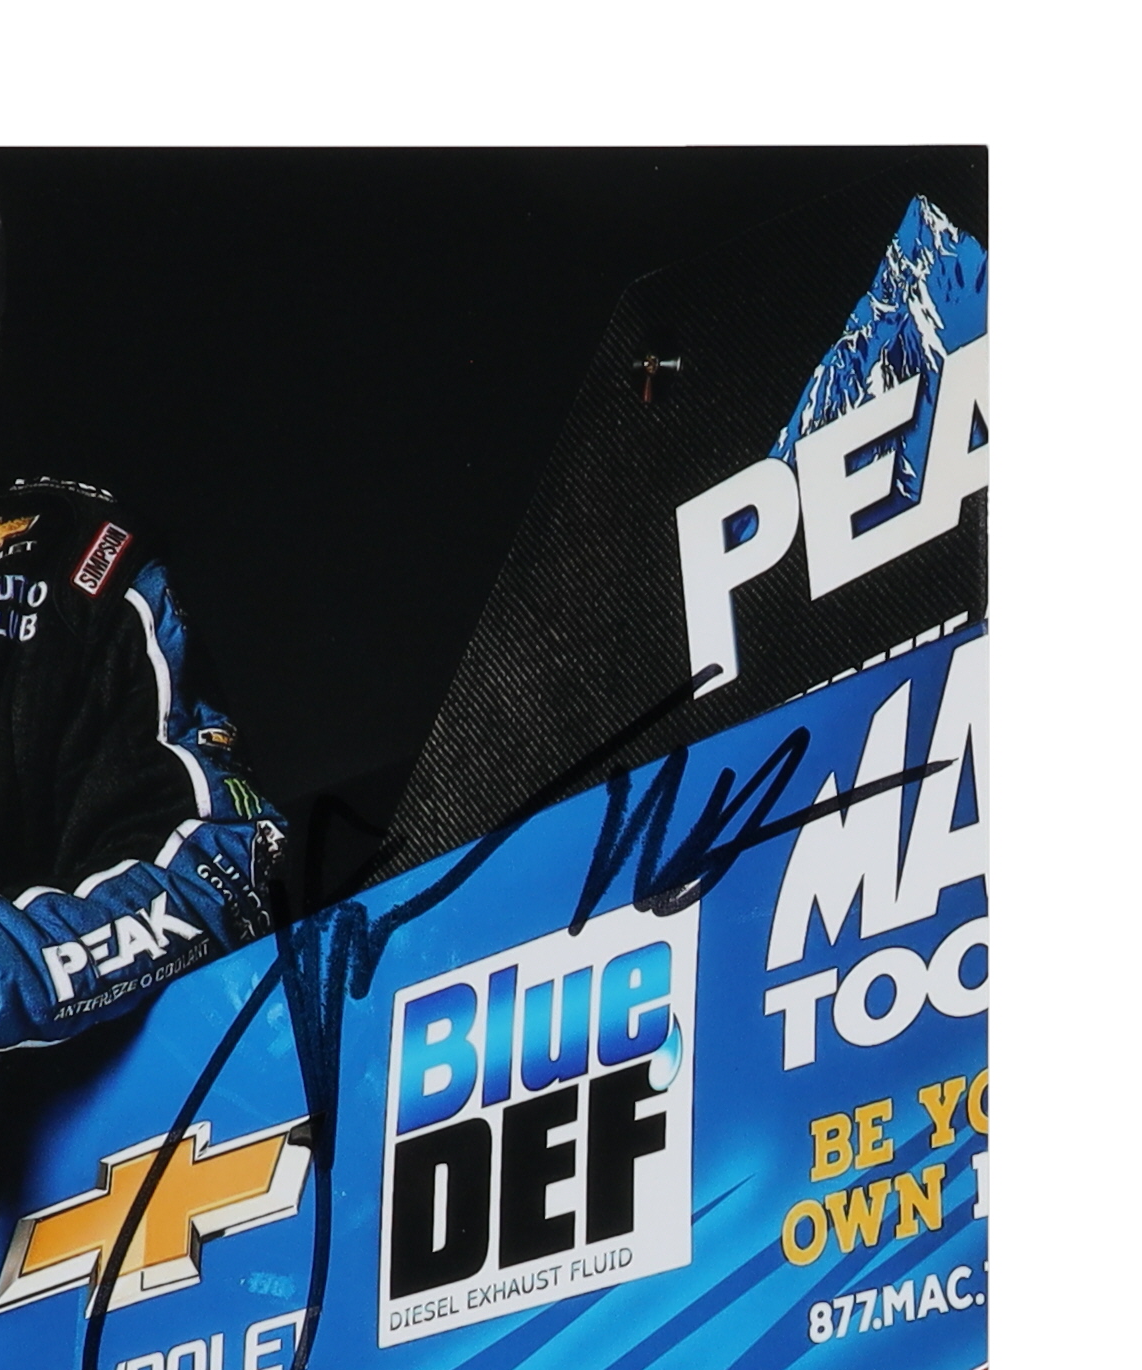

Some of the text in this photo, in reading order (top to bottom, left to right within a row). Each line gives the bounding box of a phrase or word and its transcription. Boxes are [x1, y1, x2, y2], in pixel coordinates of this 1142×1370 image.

[79, 526, 127, 588] SIMPSON
[42, 890, 204, 1002] PEAK
[53, 978, 138, 1021] ANTIFREEZE
[154, 938, 210, 983] COOLANT
[396, 940, 672, 1138] Blue
[765, 915, 989, 1072] TOO
[389, 1060, 668, 1300] DEF
[810, 1097, 894, 1183] BE
[781, 1163, 946, 1266] OWN
[389, 1247, 633, 1332] DIESEL EXHAUST FLUID
[808, 1261, 989, 1344] 877.MAC.
